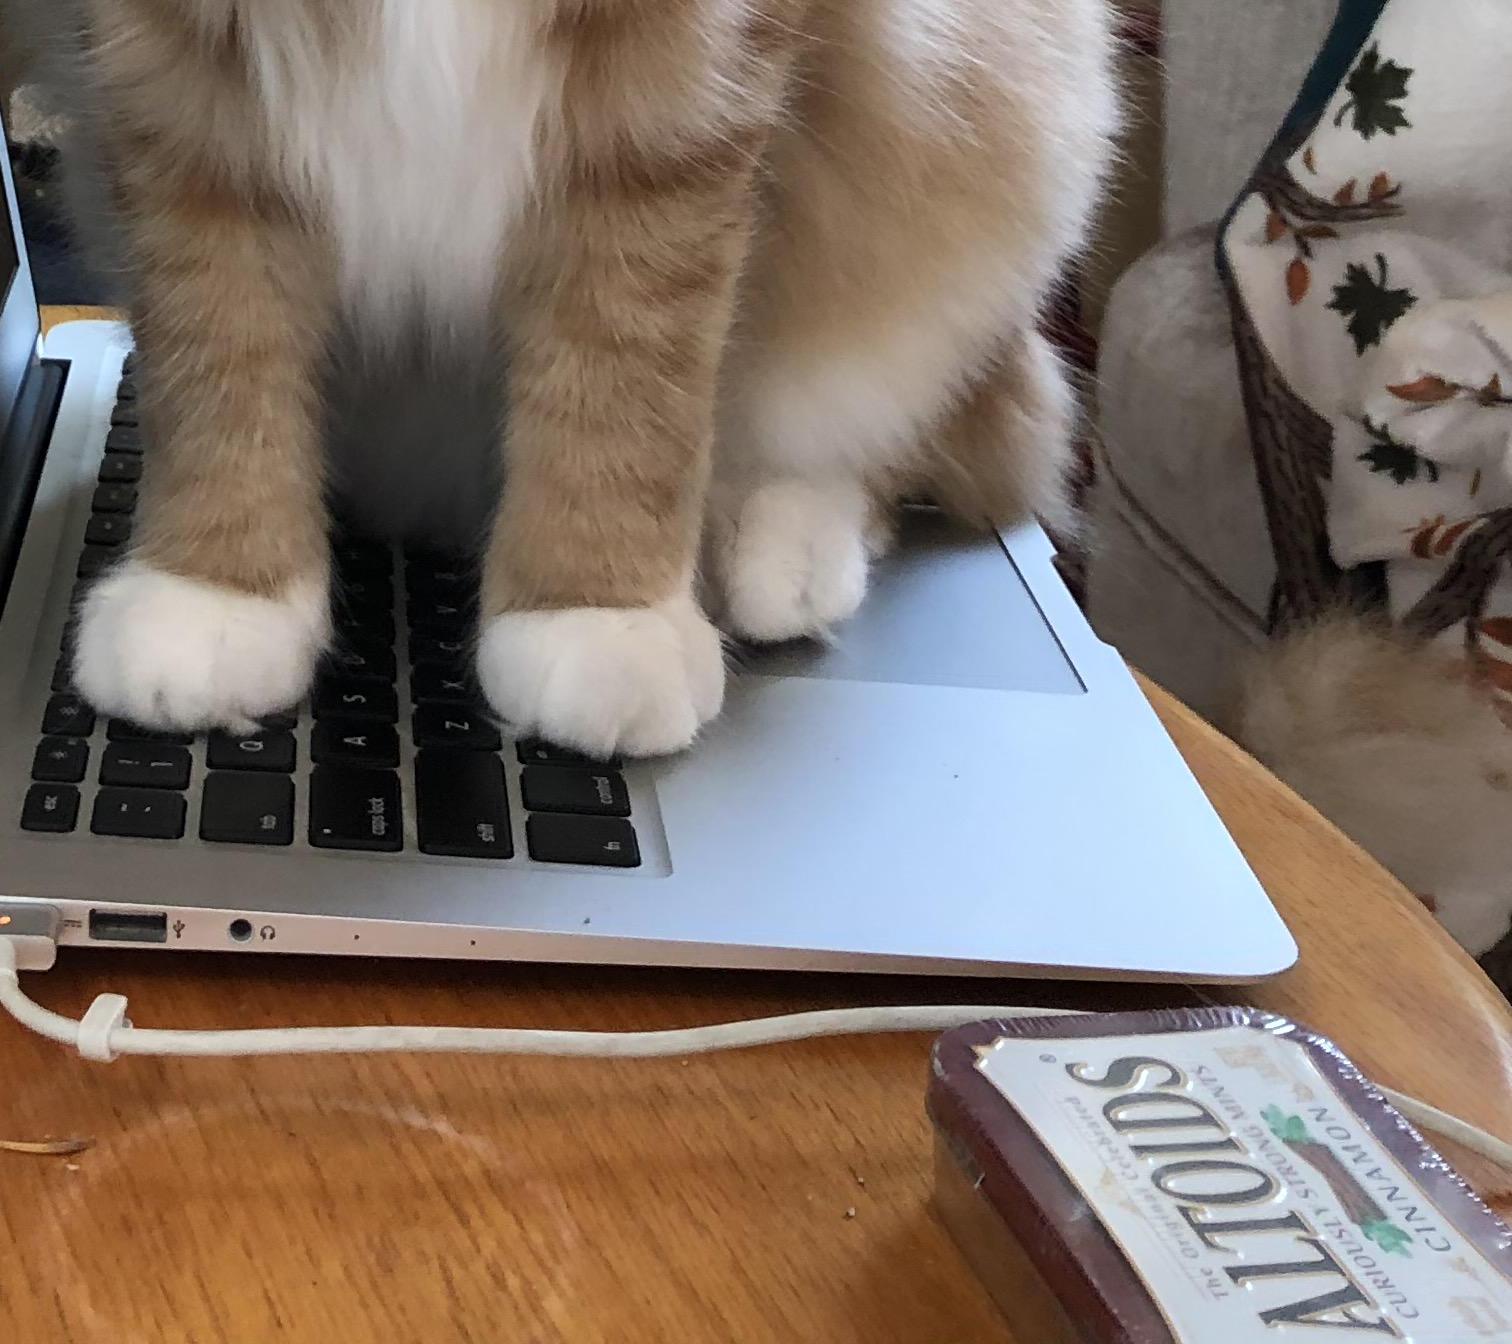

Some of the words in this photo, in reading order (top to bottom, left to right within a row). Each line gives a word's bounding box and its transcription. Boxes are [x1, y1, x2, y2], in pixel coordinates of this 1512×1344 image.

[342, 693, 367, 704] S
[442, 679, 465, 691] X
[343, 735, 368, 747] A
[444, 720, 470, 732] Z
[239, 740, 264, 753] Q
[1191, 1063, 1245, 1129] MINTS
[1242, 1124, 1311, 1202] STRONG
[1306, 1105, 1453, 1254] CINNAMON
[1065, 1056, 1406, 1339] ALTOIDS
[1311, 1205, 1420, 1320] CURIOUSLY
[1199, 1266, 1230, 1300] The
